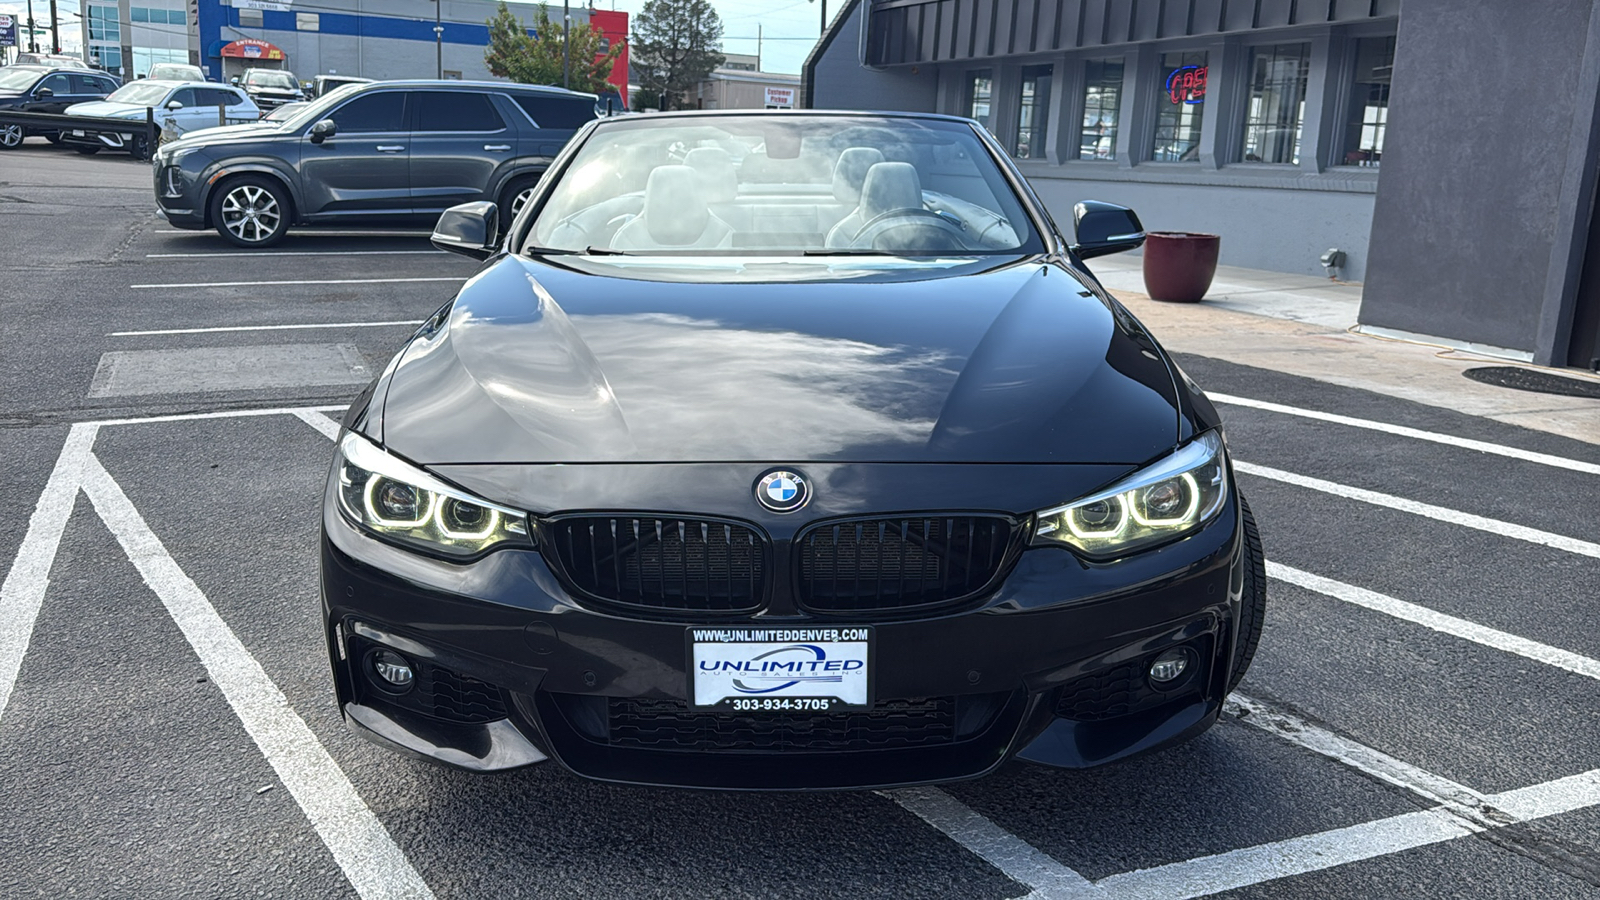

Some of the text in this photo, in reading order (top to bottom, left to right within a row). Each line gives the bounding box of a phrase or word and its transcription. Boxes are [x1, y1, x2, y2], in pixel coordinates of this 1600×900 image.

[236, 39, 269, 48] ENTRANCE
[770, 96, 788, 104] Pickup
[693, 629, 868, 642] WWWUNLIMITEDDENVER.COM
[699, 659, 864, 672] UNLIMITED
[733, 699, 829, 710] 303-934-3705
